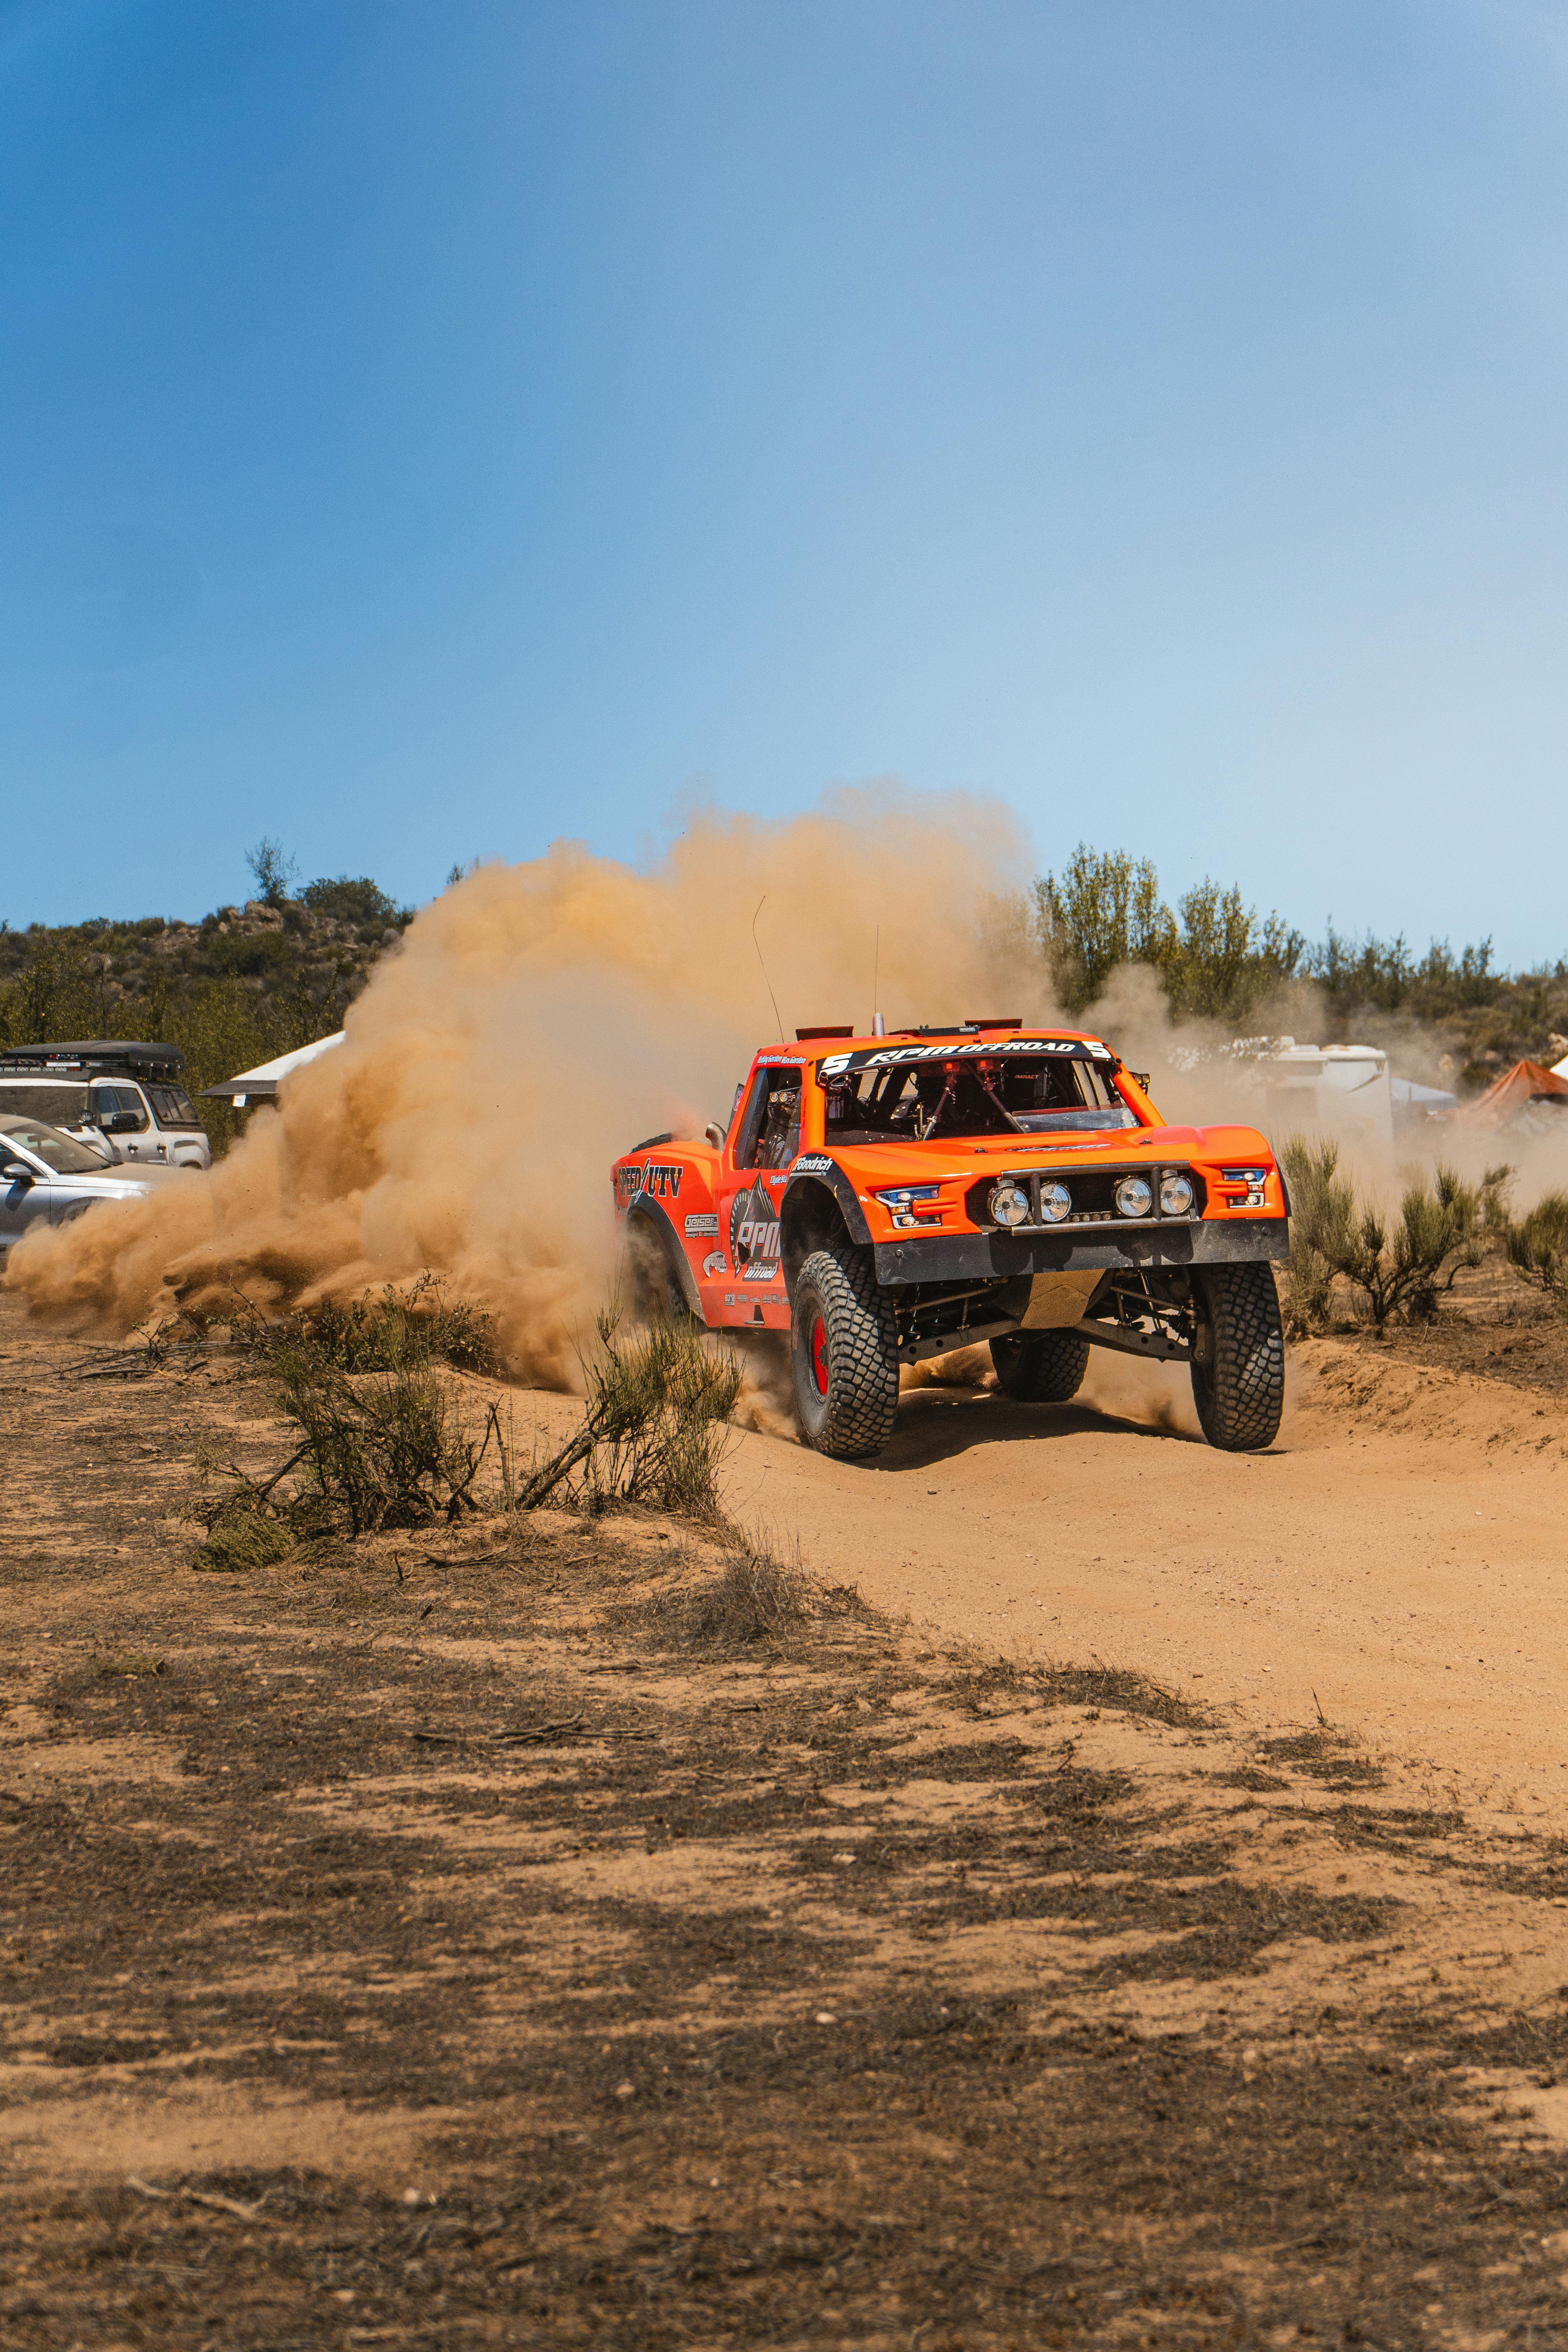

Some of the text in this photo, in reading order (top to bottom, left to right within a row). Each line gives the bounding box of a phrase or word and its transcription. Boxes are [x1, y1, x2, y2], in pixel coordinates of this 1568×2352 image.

[819, 1041, 1111, 1075] 5 RPM OFFROAD 5
[792, 1157, 833, 1171] FGoodrich
[735, 1221, 780, 1257] RPM
[744, 1262, 778, 1278] offroad
